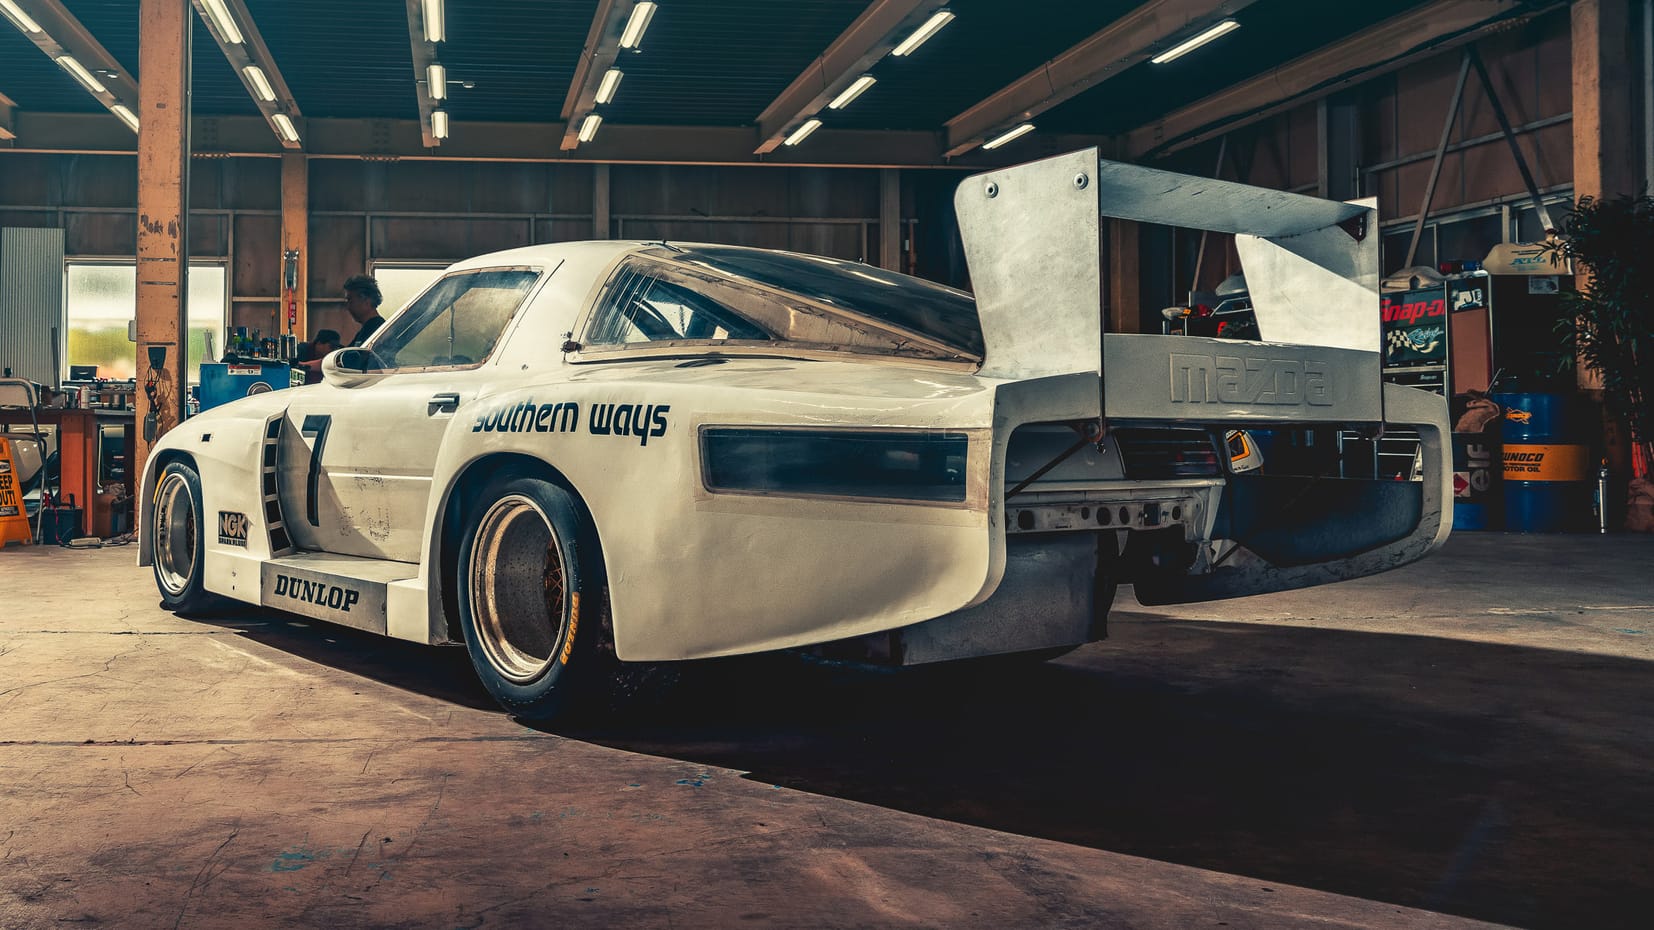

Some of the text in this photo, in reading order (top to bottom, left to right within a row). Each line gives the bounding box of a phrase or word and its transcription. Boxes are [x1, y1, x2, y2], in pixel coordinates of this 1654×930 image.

[1381, 299, 1445, 325] Snap-o
[1169, 352, 1333, 407] mazda
[471, 395, 671, 447] southern ways
[301, 414, 333, 527] 7
[1503, 452, 1545, 462] UNOCO
[0, 475, 13, 490] EEP
[219, 513, 247, 538] NGK
[274, 574, 360, 612] DUNLOP
